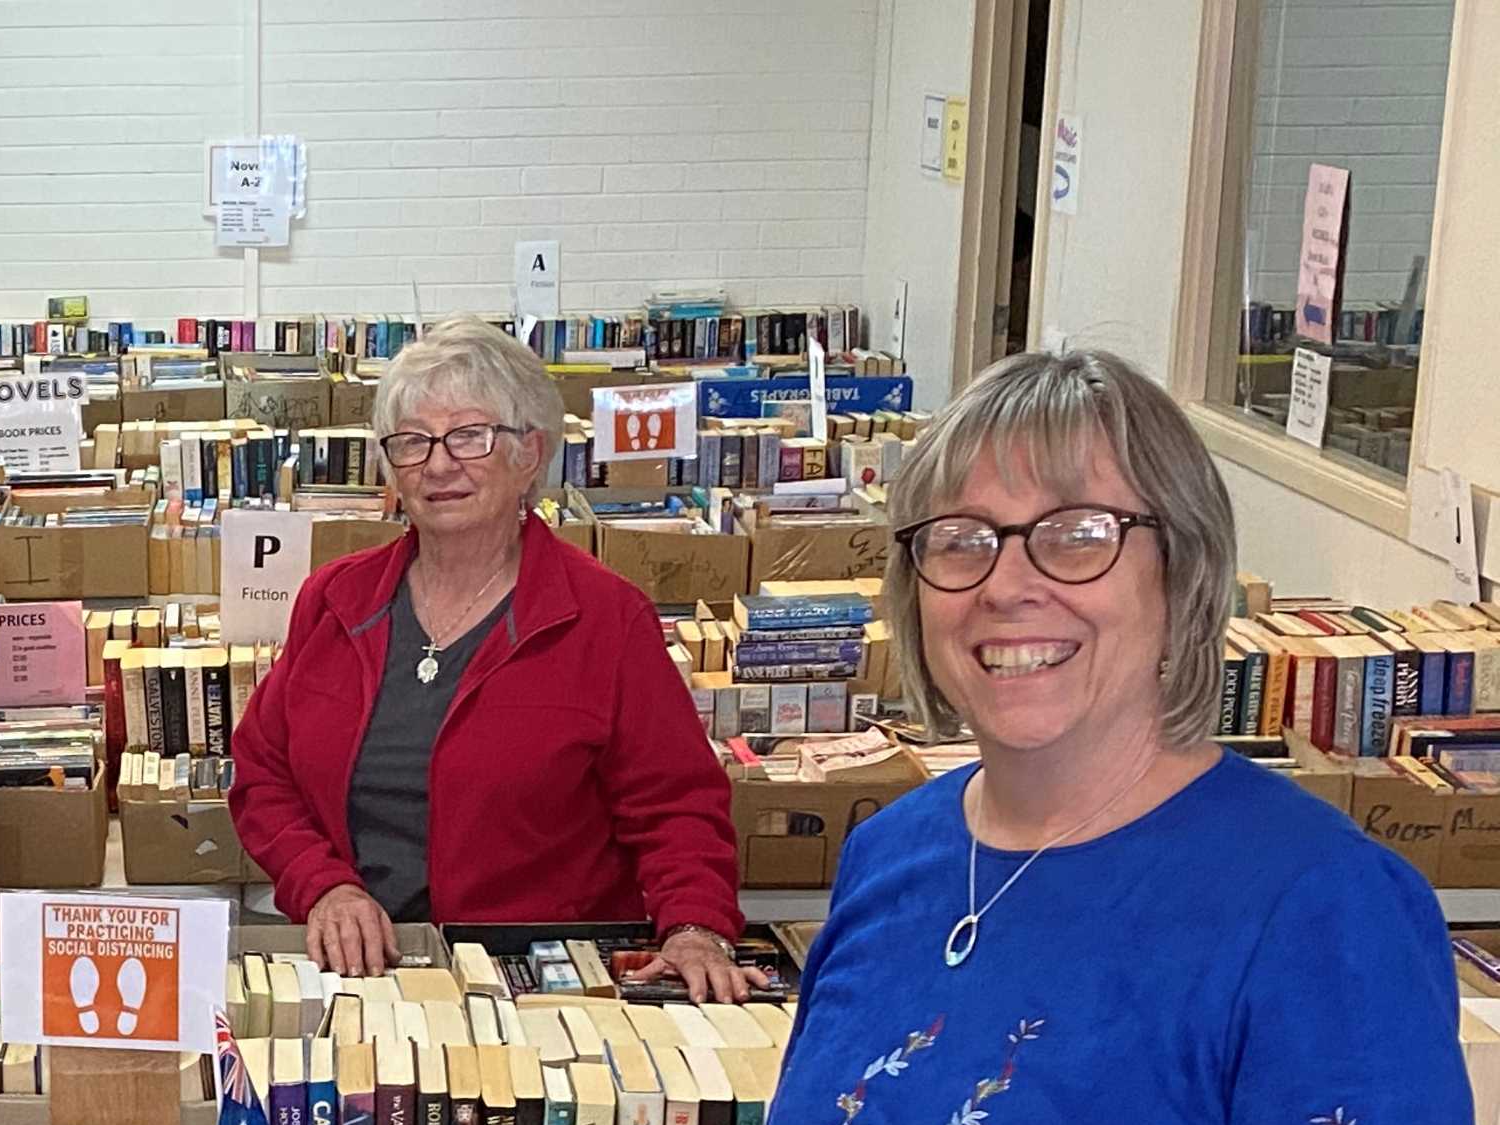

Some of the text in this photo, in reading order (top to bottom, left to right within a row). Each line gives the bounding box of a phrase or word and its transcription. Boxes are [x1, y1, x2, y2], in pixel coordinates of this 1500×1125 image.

[531, 253, 546, 272] A
[29, 425, 62, 437] PRICES
[253, 535, 281, 568] P
[241, 586, 290, 601] Fiction
[1370, 659, 1390, 750] deep freeze
[150, 678, 164, 757] GALVESTON
[52, 907, 170, 926] THANK YOU FOR
[67, 924, 156, 940] PRACTICING
[48, 940, 174, 959] SOCIAL DISTANCING
